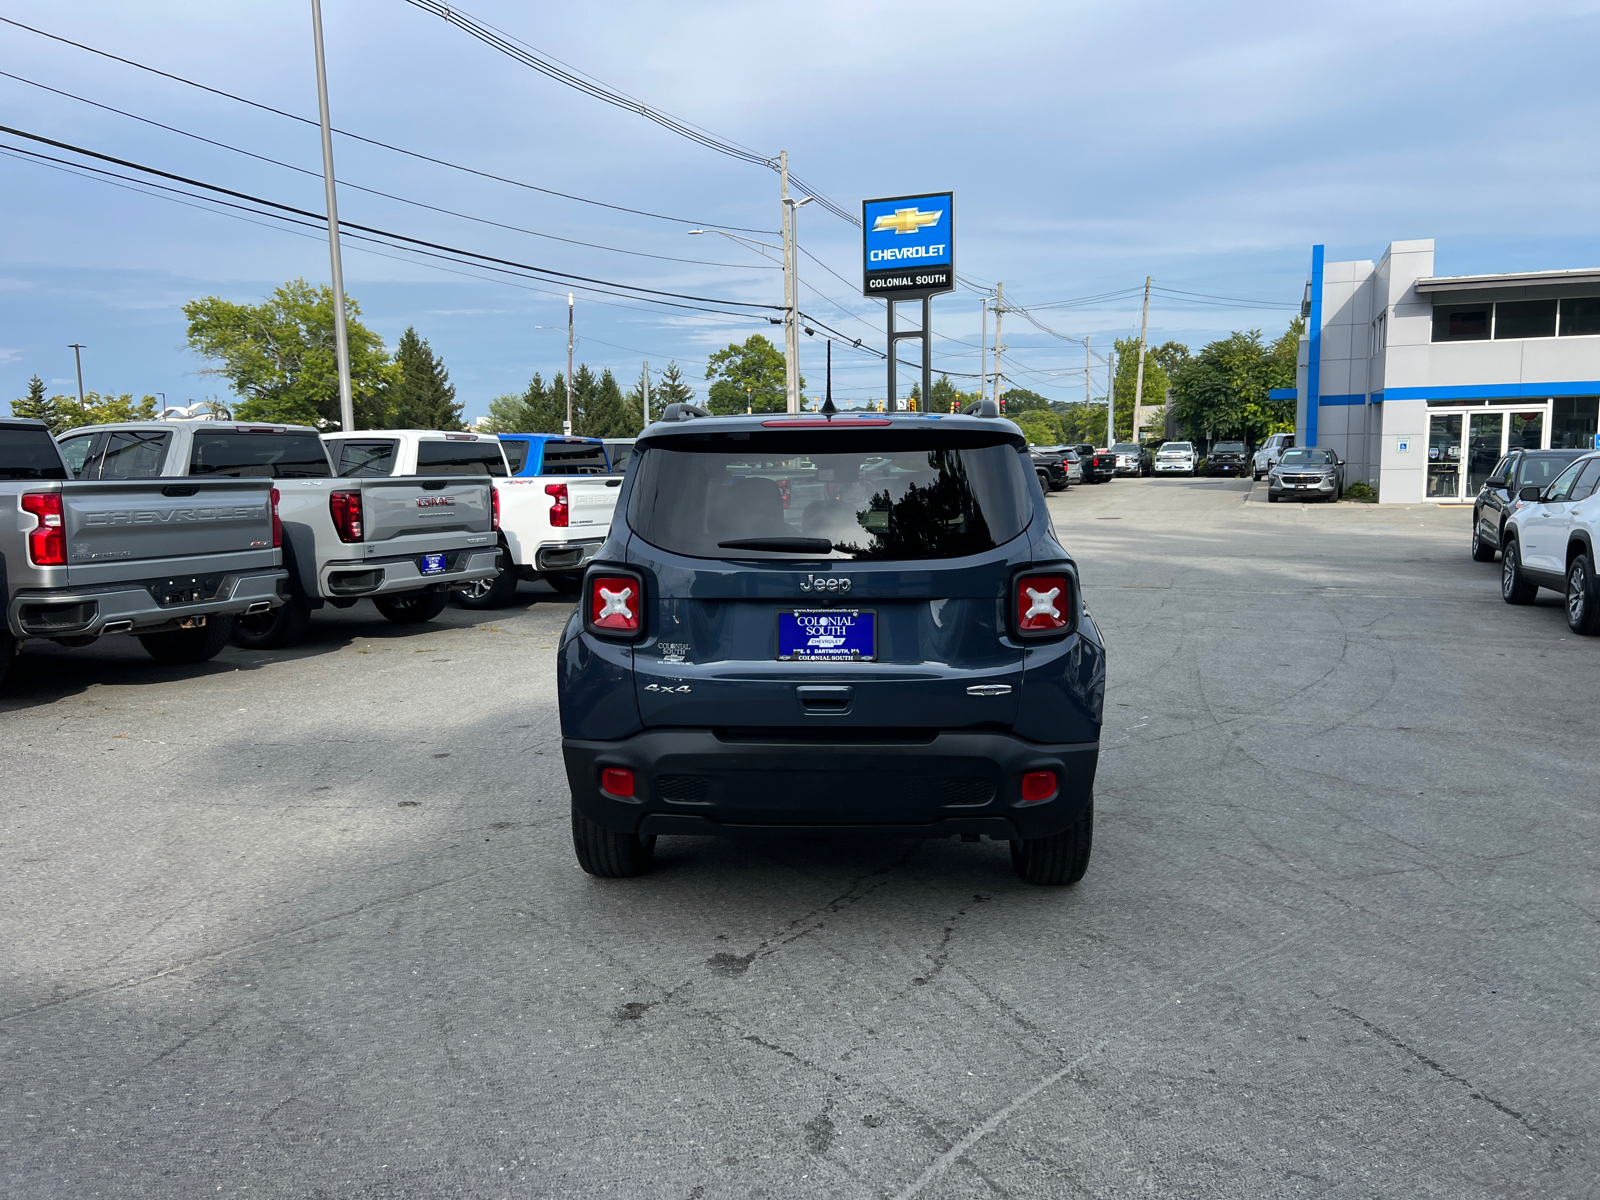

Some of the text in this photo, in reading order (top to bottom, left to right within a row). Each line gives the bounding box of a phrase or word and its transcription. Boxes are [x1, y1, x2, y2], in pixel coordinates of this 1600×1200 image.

[870, 244, 946, 262] CHEVROLET
[869, 274, 946, 288] COLONIAL SOUTH
[416, 496, 456, 508] GMC
[85, 505, 264, 526] CHEVROLET
[800, 574, 852, 596] Jeep
[797, 616, 855, 626] COLONIAL
[806, 626, 846, 635] SOUTH
[644, 683, 692, 693] 4x4
